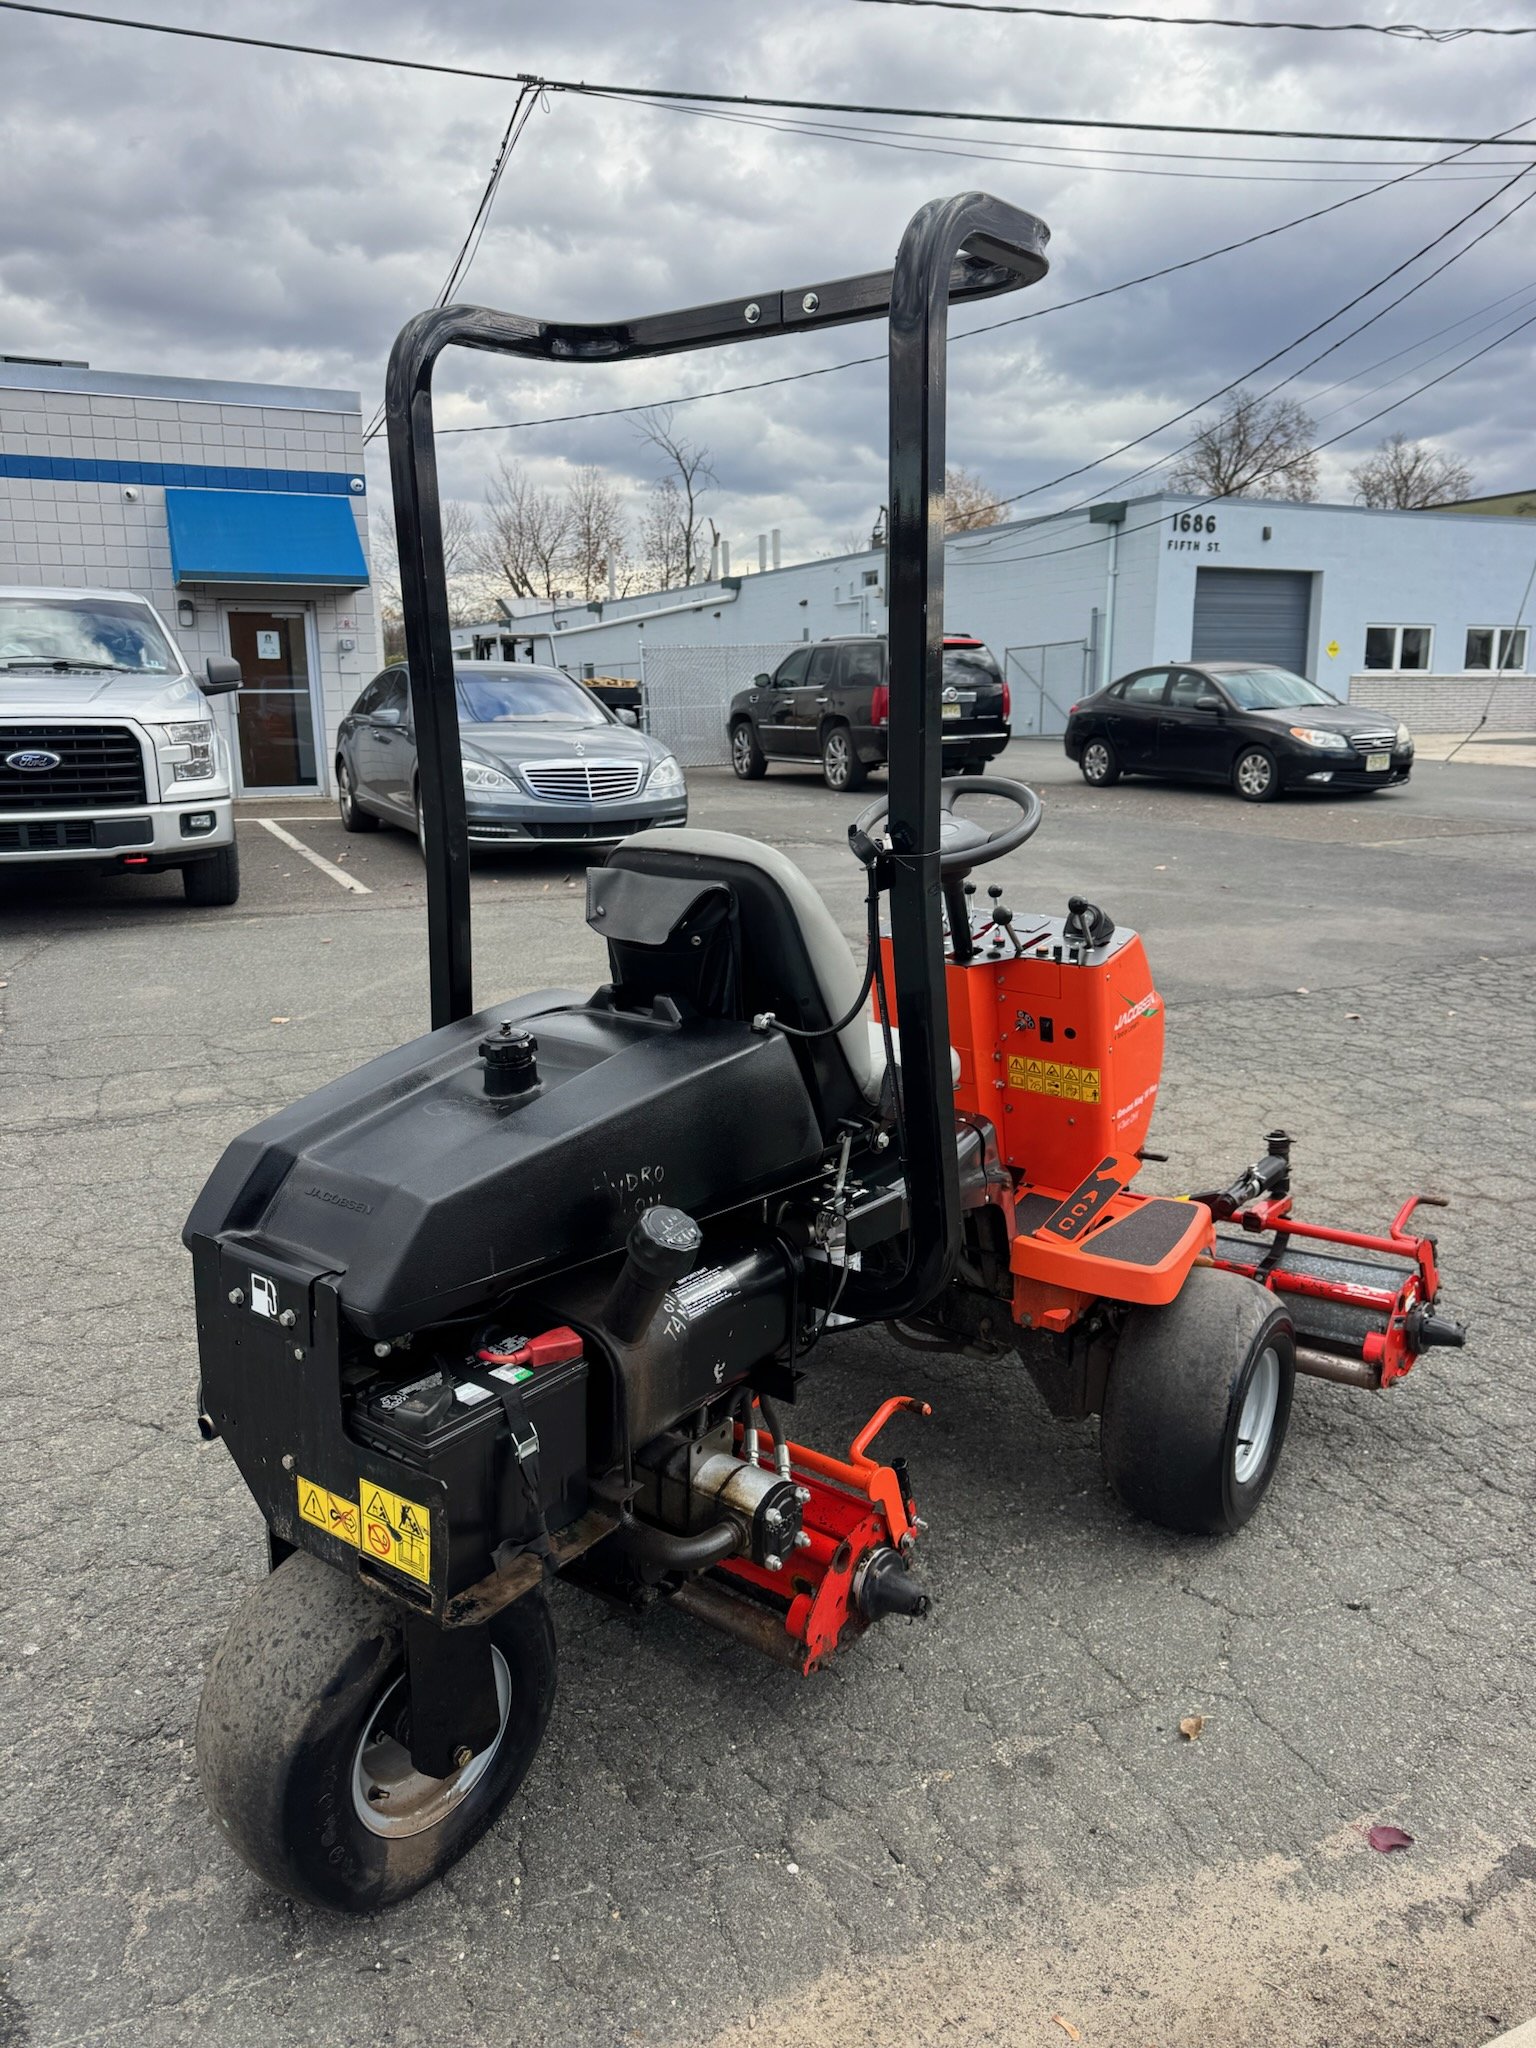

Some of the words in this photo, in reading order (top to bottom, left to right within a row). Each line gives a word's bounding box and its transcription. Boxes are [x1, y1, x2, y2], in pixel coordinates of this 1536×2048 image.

[1173, 513, 1217, 533] 1686
[1167, 540, 1201, 551] FIFTH
[20, 754, 48, 767] Ford
[304, 1187, 375, 1216] JACOBSEN
